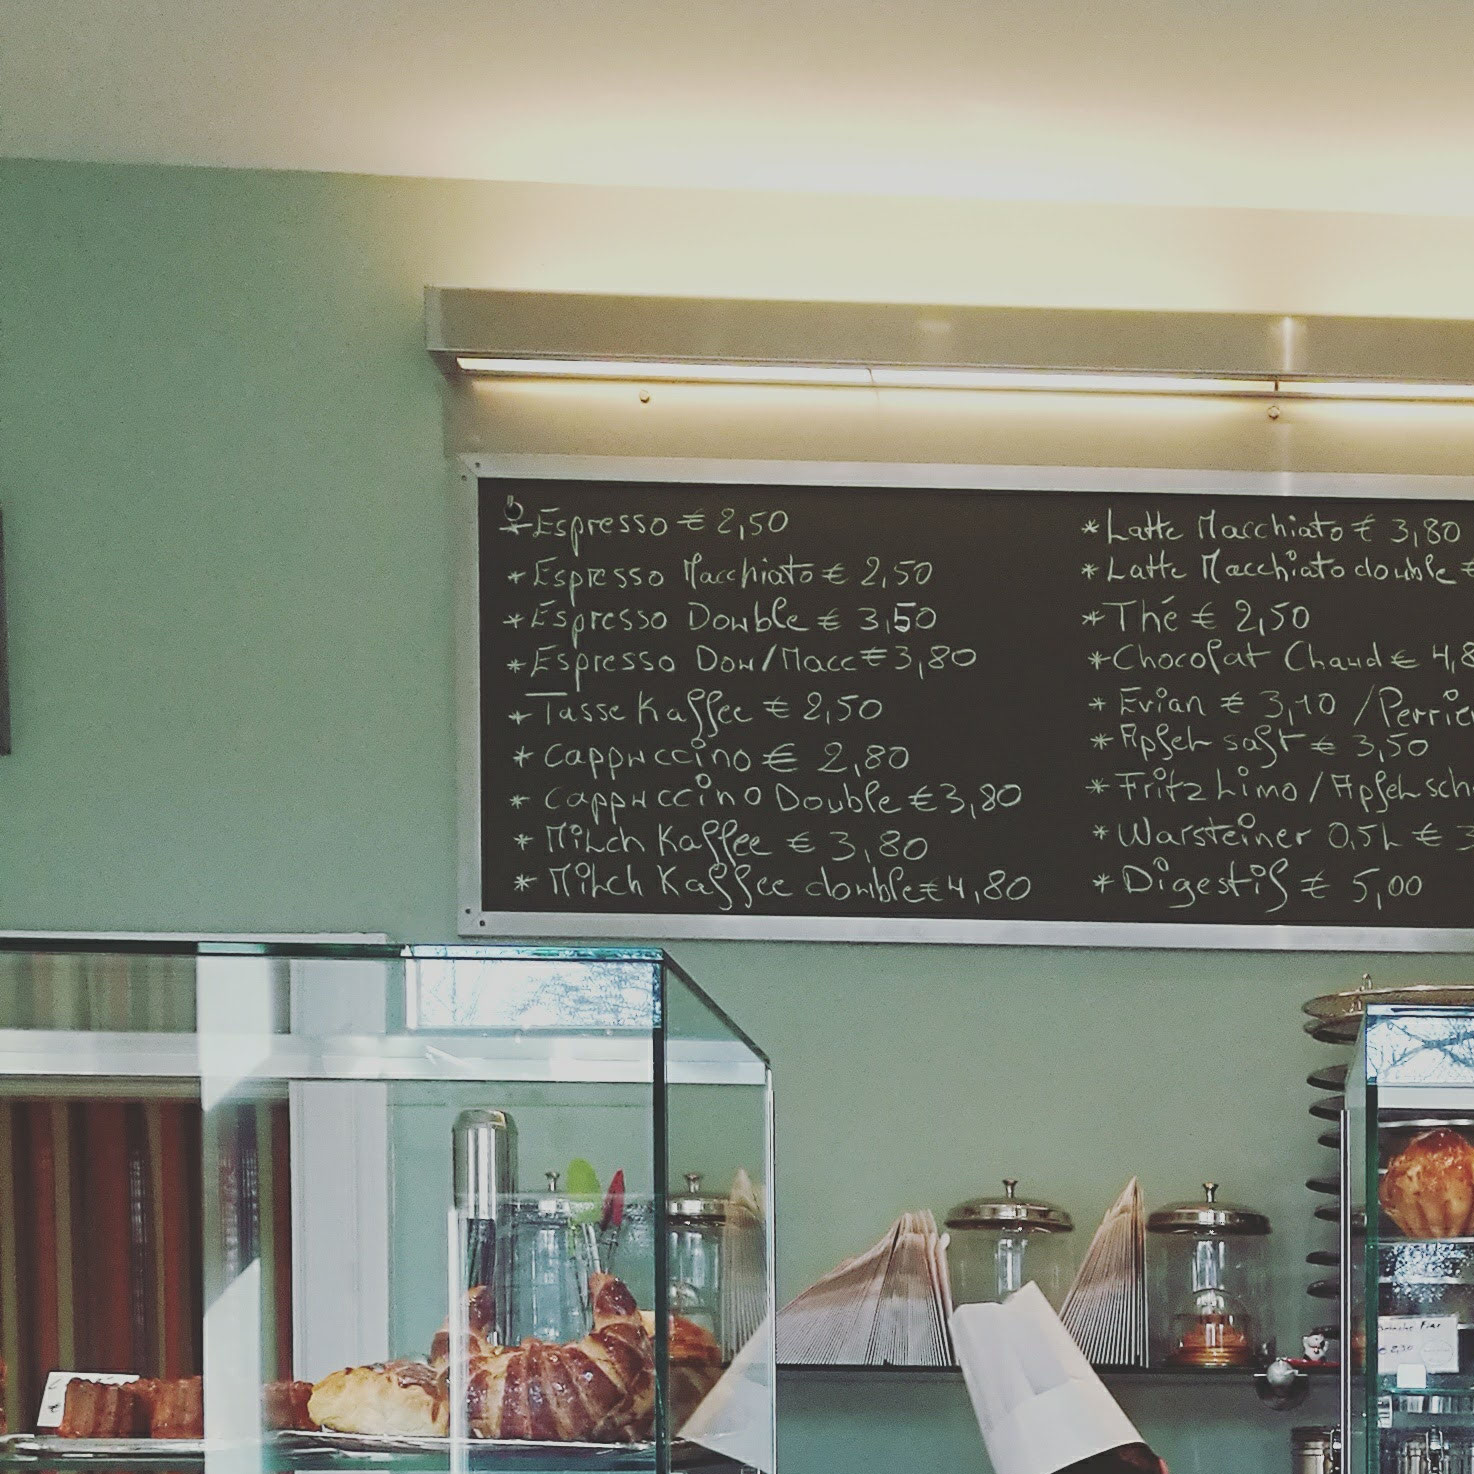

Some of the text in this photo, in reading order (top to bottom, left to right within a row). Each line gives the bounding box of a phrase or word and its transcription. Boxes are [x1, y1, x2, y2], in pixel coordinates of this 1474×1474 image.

[533, 508, 788, 557] Espresso € 2,50
[1108, 509, 1460, 547] Latte Macchiato € 3,80
[534, 552, 932, 607] Espresso Macchiato € 2,50
[1107, 550, 1187, 582] Latte
[1201, 548, 1345, 583] Macchiato
[1355, 554, 1457, 584] double
[531, 597, 936, 648] Espresso Double € 3,50
[1102, 596, 1309, 636] Thé € 2,50
[531, 644, 676, 692] Espresso
[1113, 639, 1271, 675] Chocolat
[1285, 641, 1383, 672] Chaud
[1391, 650, 1419, 668] €
[525, 688, 882, 741] Tasse Kaffee € 2,50
[1120, 687, 1206, 716] Evian
[1221, 692, 1244, 713] €
[545, 738, 909, 780] Cappuccino € 2,80
[1120, 723, 1212, 761] Apfel
[1311, 736, 1335, 755] €
[1353, 733, 1428, 762] 3,50
[776, 780, 901, 814] Double
[1115, 767, 1206, 802] Fritz
[546, 820, 928, 873] Milch Kaffee € 3,80
[1118, 813, 1311, 848] Warsteiner
[1412, 823, 1442, 846] €
[549, 862, 642, 897] Milch
[657, 859, 792, 910] Kaffee
[806, 866, 927, 902] double
[1122, 857, 1422, 912] Digestif € 5,00
